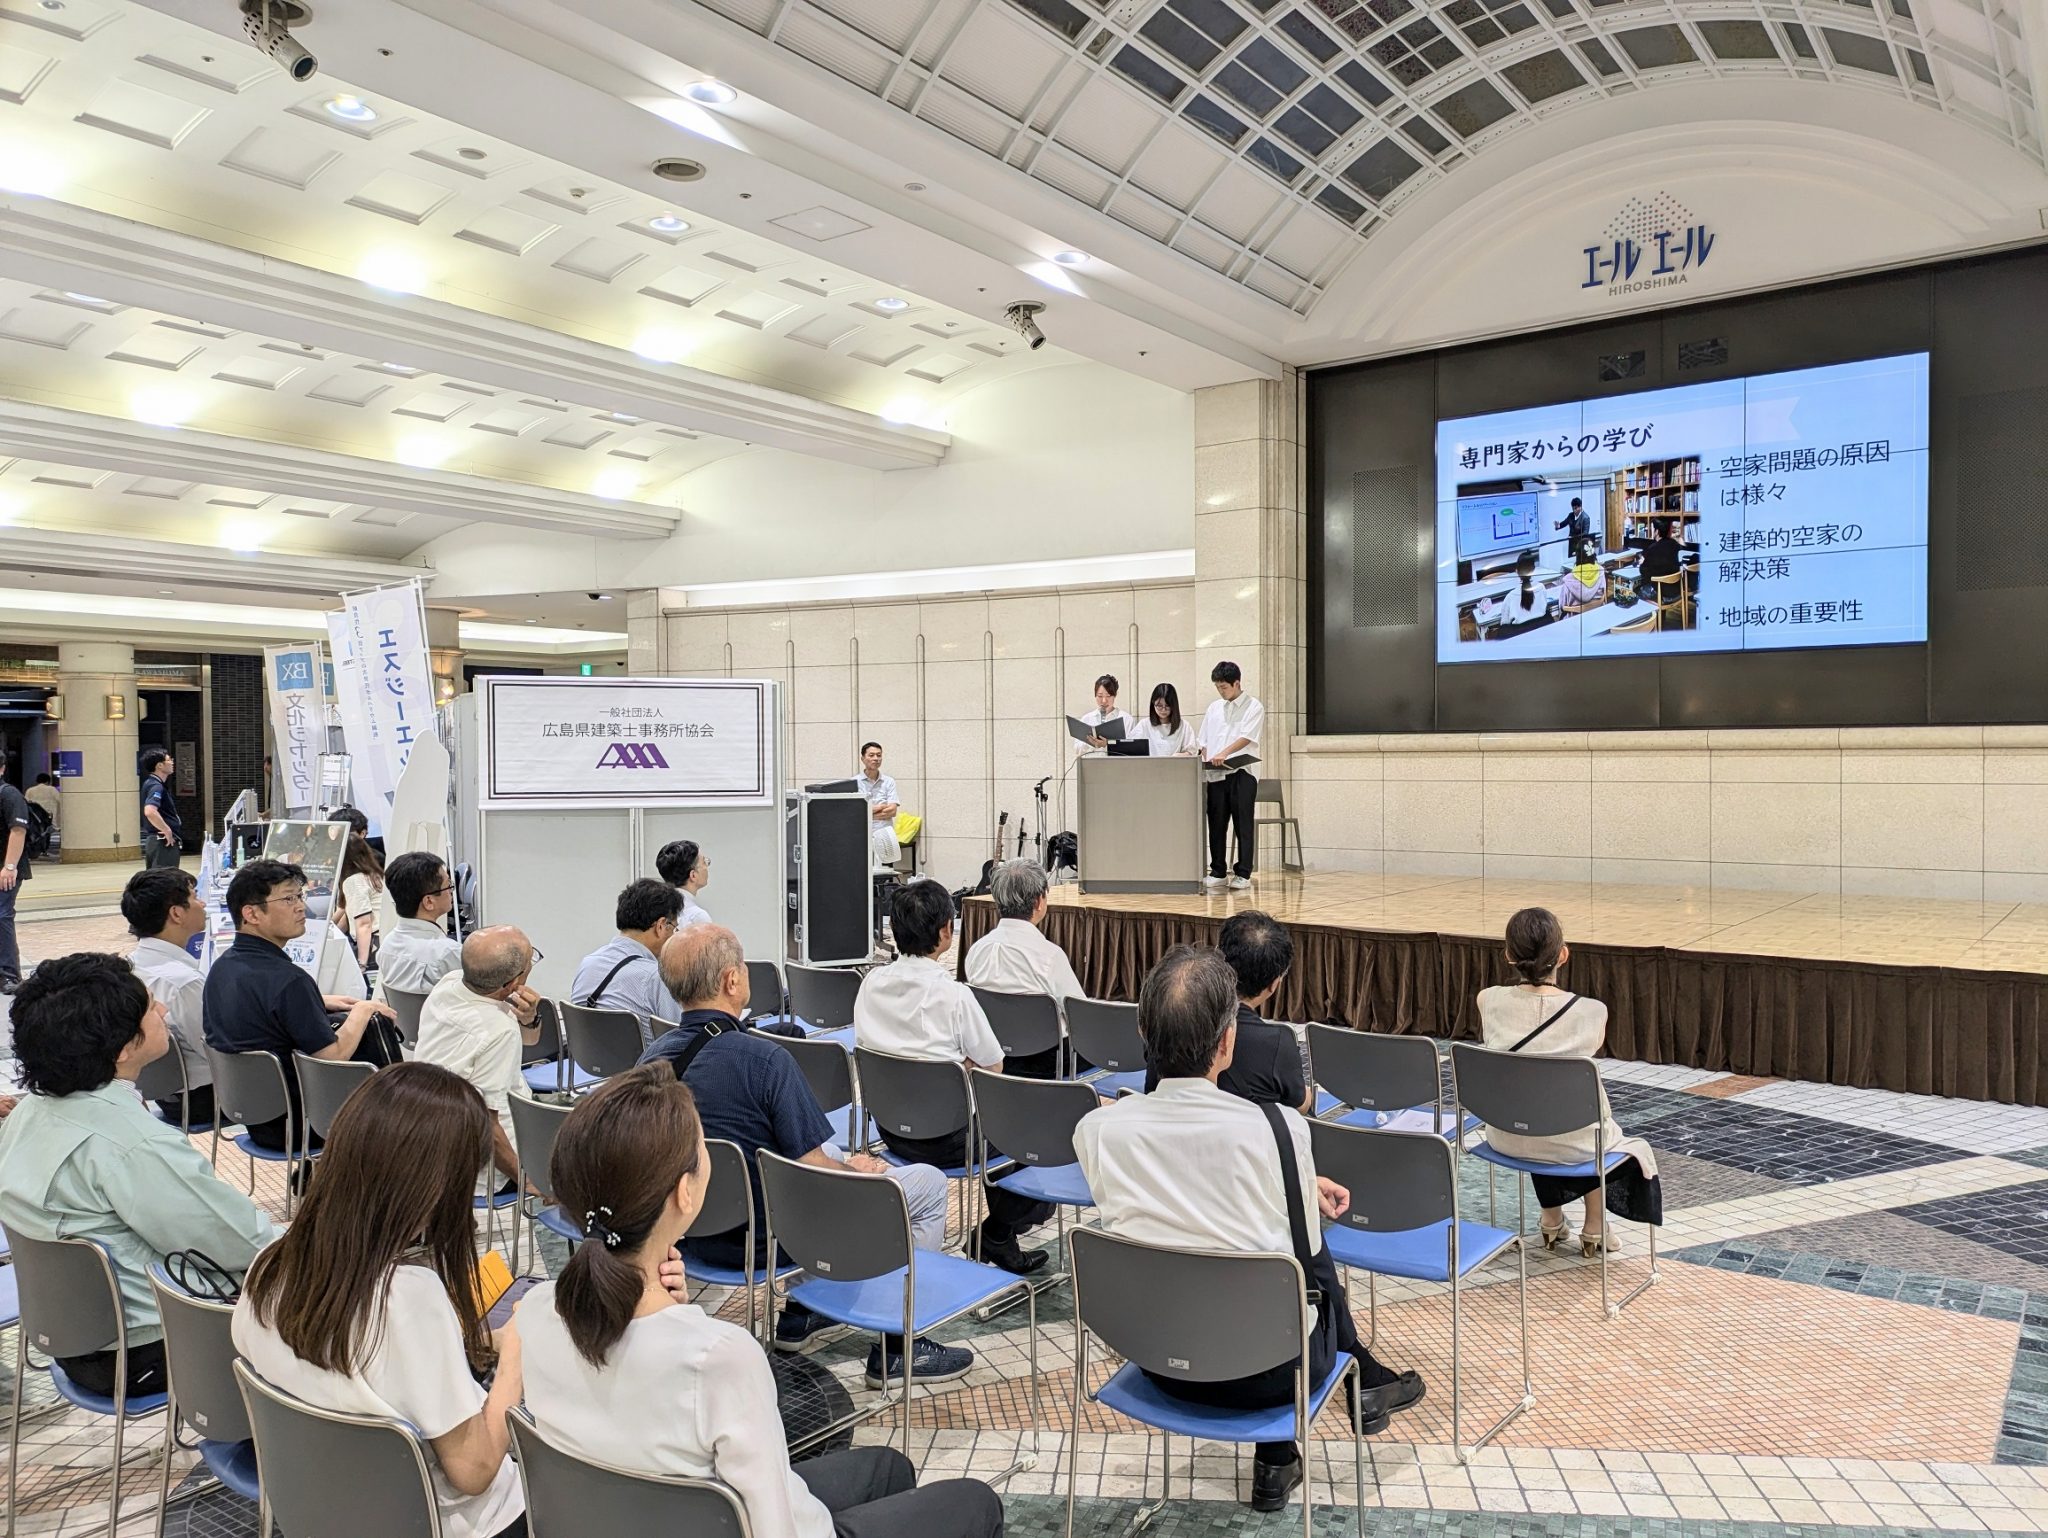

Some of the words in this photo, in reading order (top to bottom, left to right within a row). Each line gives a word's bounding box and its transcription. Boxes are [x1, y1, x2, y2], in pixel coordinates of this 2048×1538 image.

[1582, 239, 1641, 288] エール
[1652, 225, 1715, 275] エール
[1608, 273, 1688, 297] HIROSHIMA
[1459, 422, 1655, 470] 専門家からの学び
[1719, 439, 1890, 478] 空家問題の原因
[1720, 482, 1787, 507] は様々
[1719, 523, 1863, 553] 建築的空家の
[1718, 557, 1790, 583] 解決策
[1719, 599, 1864, 628] 地域の重要性
[599, 707, 664, 718] 一般社団法人
[542, 722, 715, 738] 広島県建築士事務所協会
